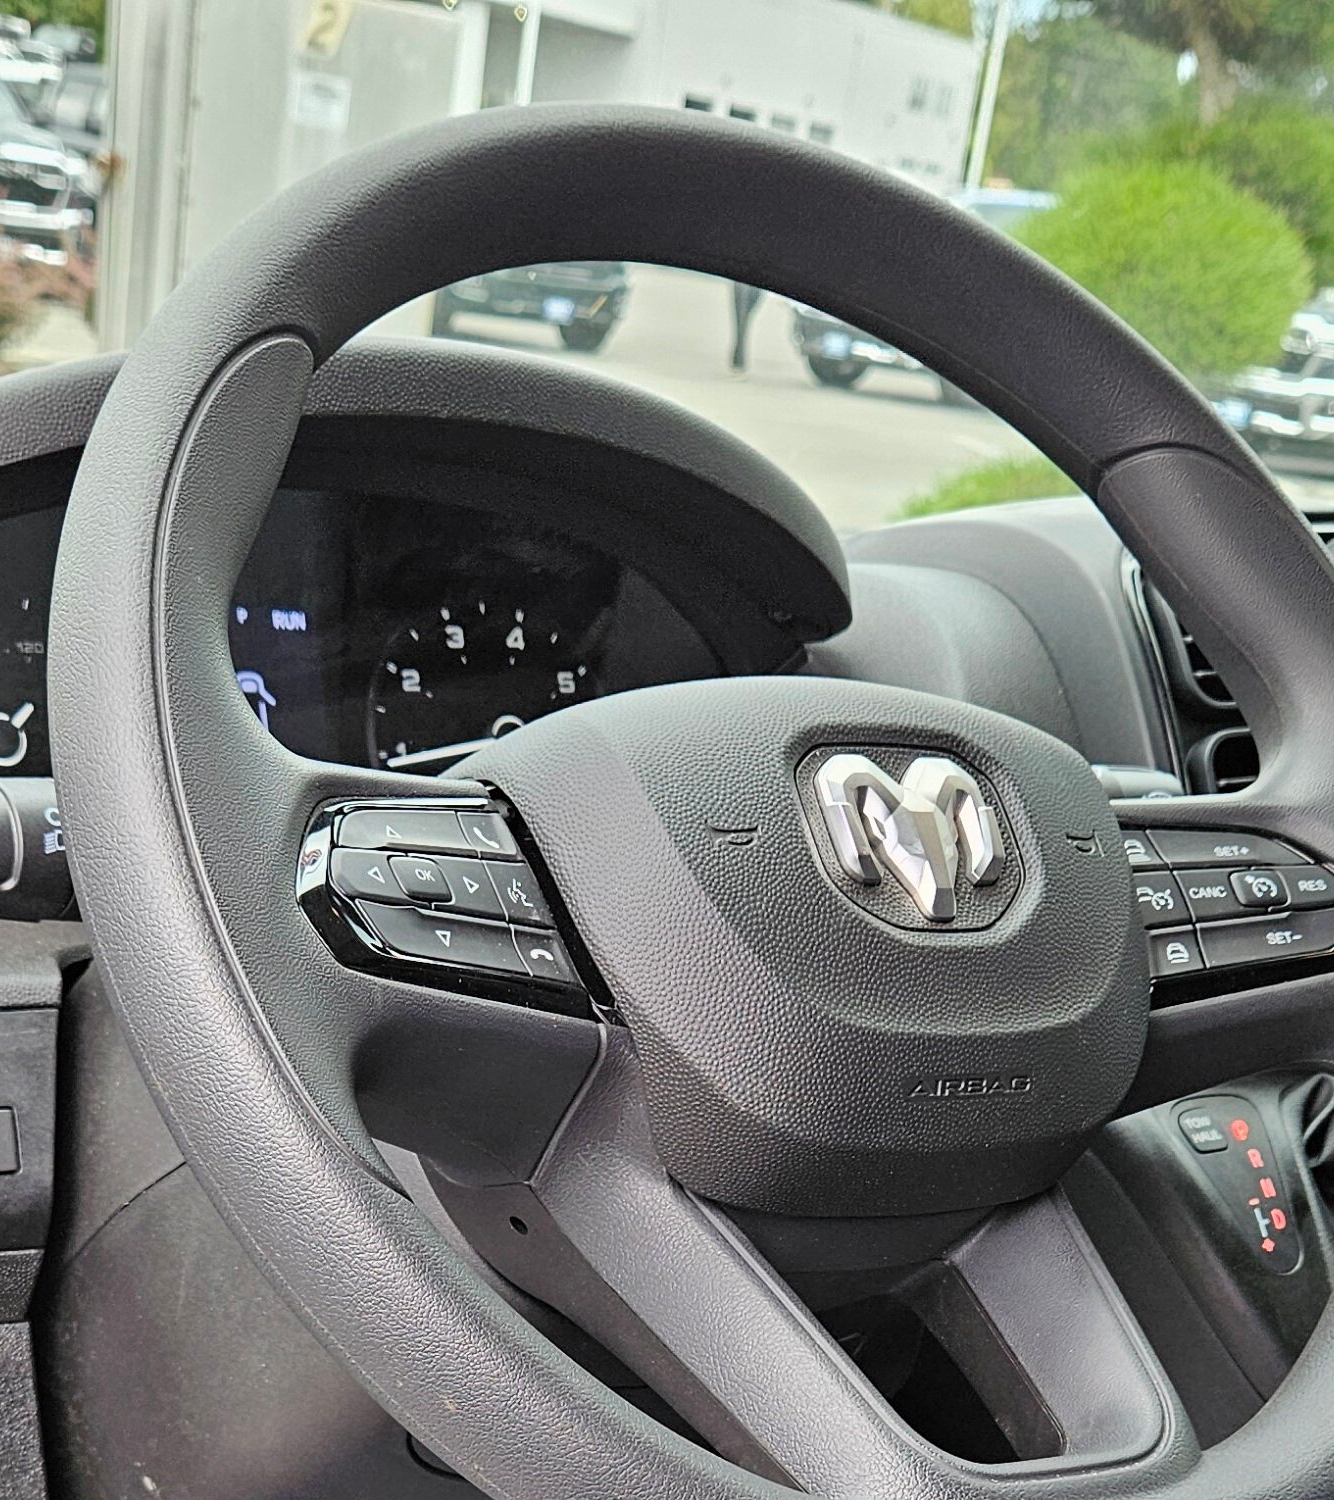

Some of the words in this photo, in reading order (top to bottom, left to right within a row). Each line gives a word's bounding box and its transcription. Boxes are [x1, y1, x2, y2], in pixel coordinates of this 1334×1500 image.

[236, 606, 248, 625] P
[272, 609, 306, 631] RUN
[445, 625, 465, 649] 3
[506, 626, 525, 651] 4
[401, 669, 421, 692] 2
[557, 671, 576, 694] 5
[415, 868, 436, 882] OK
[1298, 879, 1327, 892] RES
[1189, 886, 1227, 899] CANC
[908, 1076, 1032, 1098] AIRBAG
[1185, 1116, 1211, 1128] TOW
[1191, 1129, 1223, 1144] HAUL
[1247, 1149, 1264, 1168] R
[1271, 1208, 1286, 1230] D
